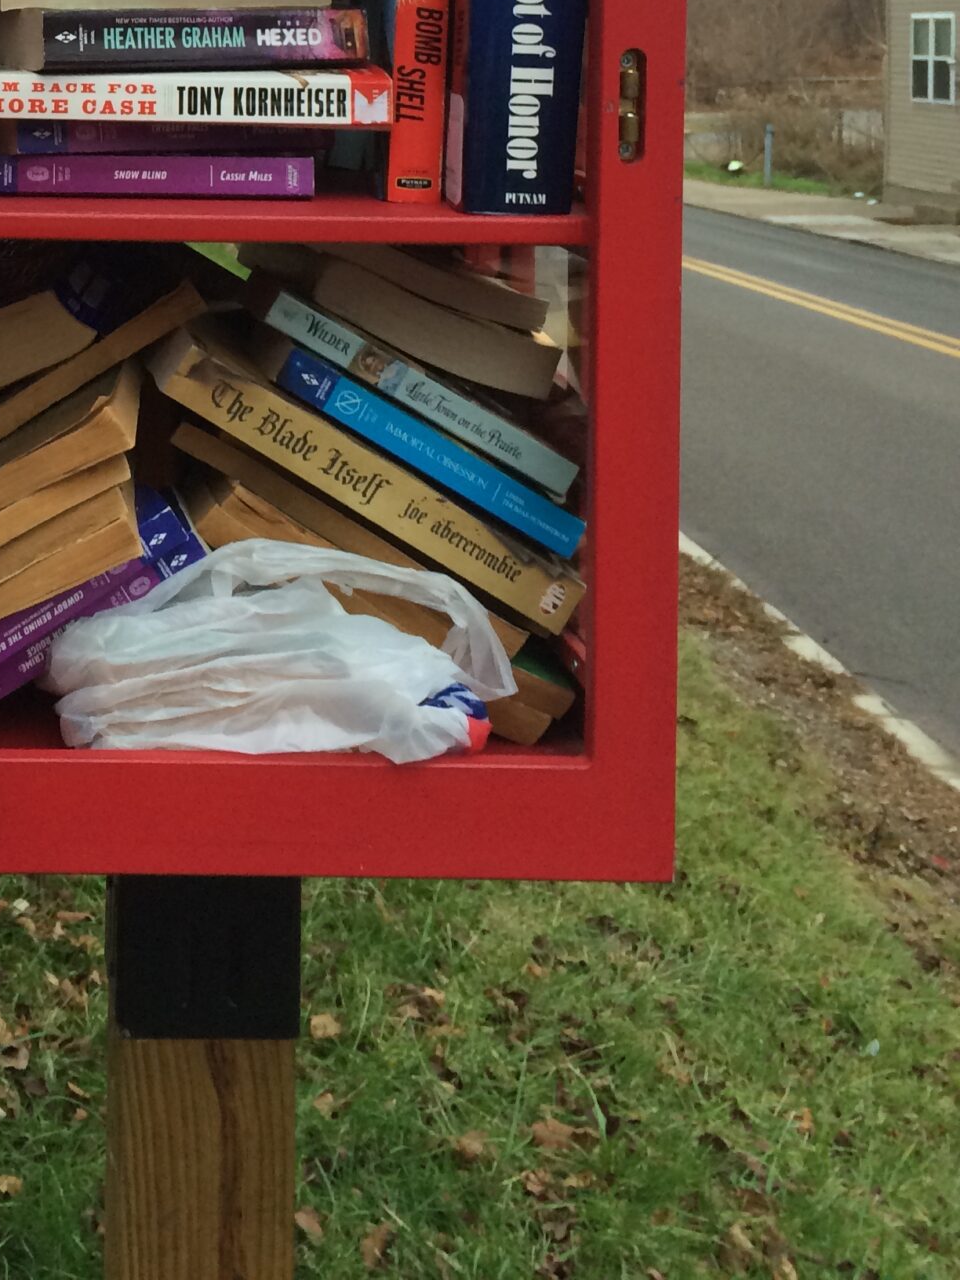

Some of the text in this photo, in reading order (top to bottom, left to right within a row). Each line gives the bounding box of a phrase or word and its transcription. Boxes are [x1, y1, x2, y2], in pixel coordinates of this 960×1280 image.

[103, 26, 176, 50] HEATHER
[181, 26, 246, 49] GRAHAM
[256, 28, 322, 47] HEXED
[414, 6, 443, 66] BOMB
[511, 23, 556, 58] of
[32, 82, 96, 93] BACK
[108, 84, 157, 94] FOR
[176, 86, 347, 118] TONY KORNHEISER
[395, 65, 427, 123] SHELL
[82, 100, 157, 115] CASH
[506, 65, 555, 179] Honor
[114, 170, 168, 180] SNOW BLIND
[505, 192, 546, 205] PUTNAM
[306, 314, 351, 356] WILDER
[405, 382, 522, 459] Little Town on the Prairie
[211, 379, 254, 423] The
[254, 407, 318, 462] Blade
[318, 447, 393, 506] Itself
[385, 422, 489, 489] IMMORTAL OBSESSION
[398, 499, 522, 583] joe abercrombie
[53, 590, 84, 615] COWBOY
[7, 633, 23, 647] THE
[23, 612, 53, 636] BEHIND
